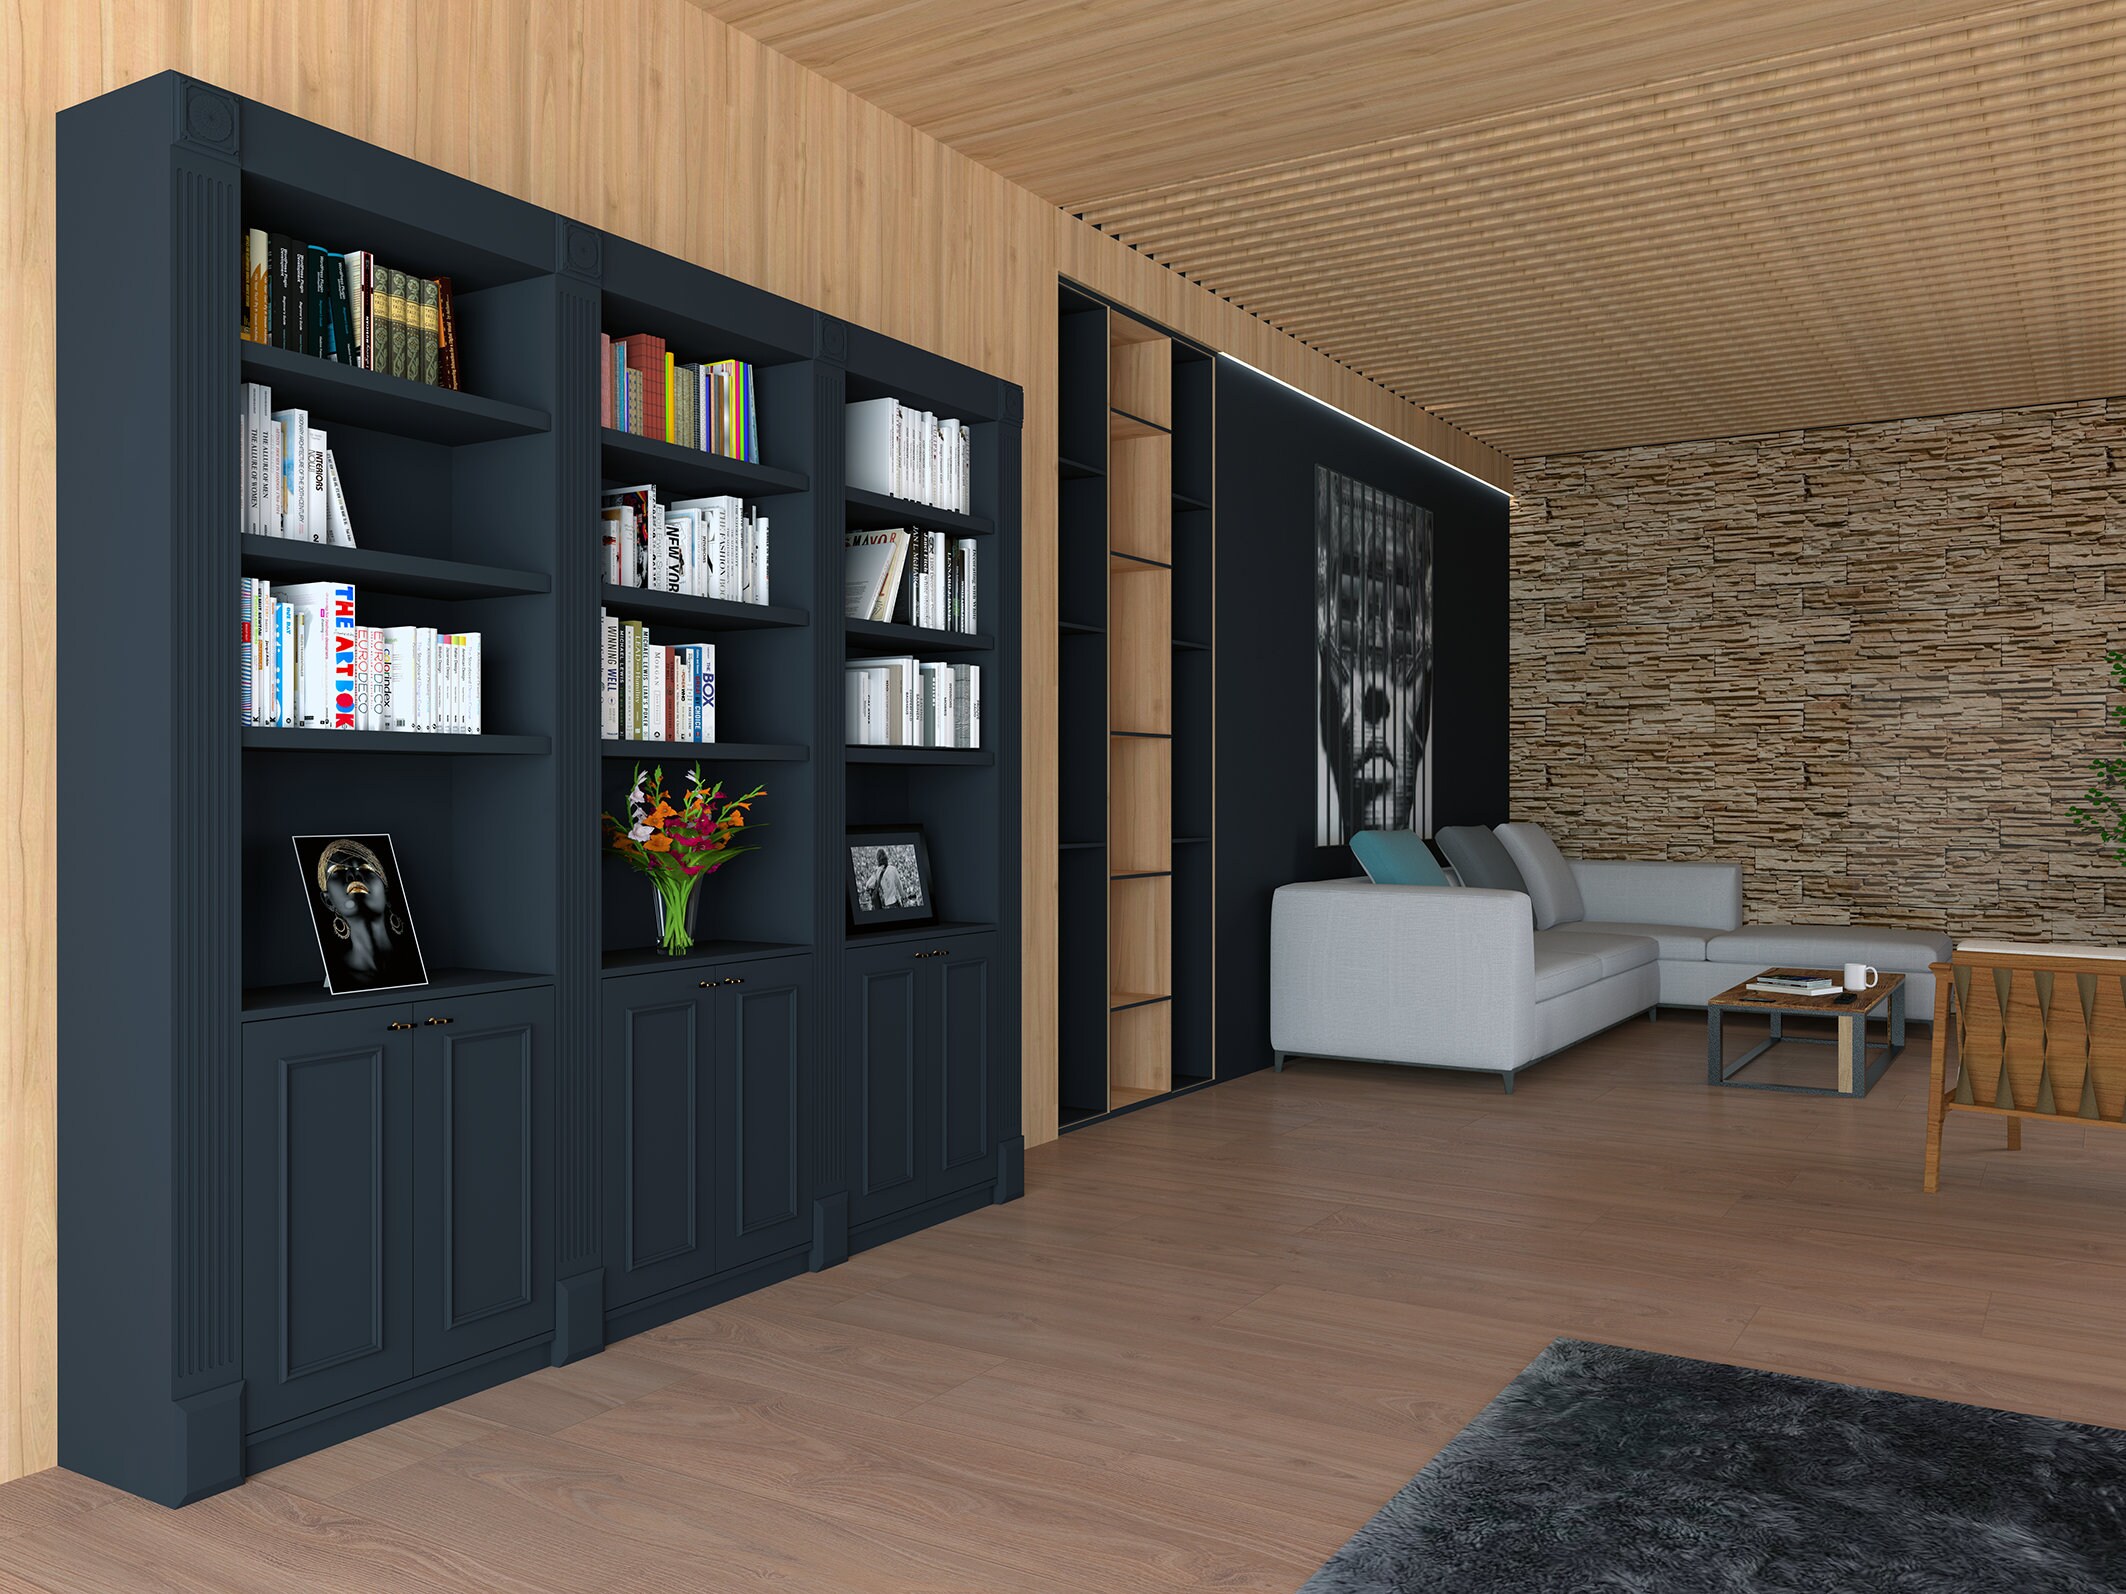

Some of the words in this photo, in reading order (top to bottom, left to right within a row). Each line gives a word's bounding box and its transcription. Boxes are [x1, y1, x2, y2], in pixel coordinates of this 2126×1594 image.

[251, 470, 258, 480] OF
[263, 472, 268, 482] OF
[315, 450, 324, 492] INTERIORS
[313, 534, 319, 542] 2
[669, 564, 679, 592] YOR
[336, 586, 354, 628] THE
[336, 636, 354, 676] ART
[607, 626, 617, 665] WINNING
[358, 630, 368, 713] EURODECO
[374, 631, 383, 714] EURODECO
[384, 649, 392, 707] colorindex
[607, 668, 617, 692] WELL
[703, 673, 714, 707] BOX
